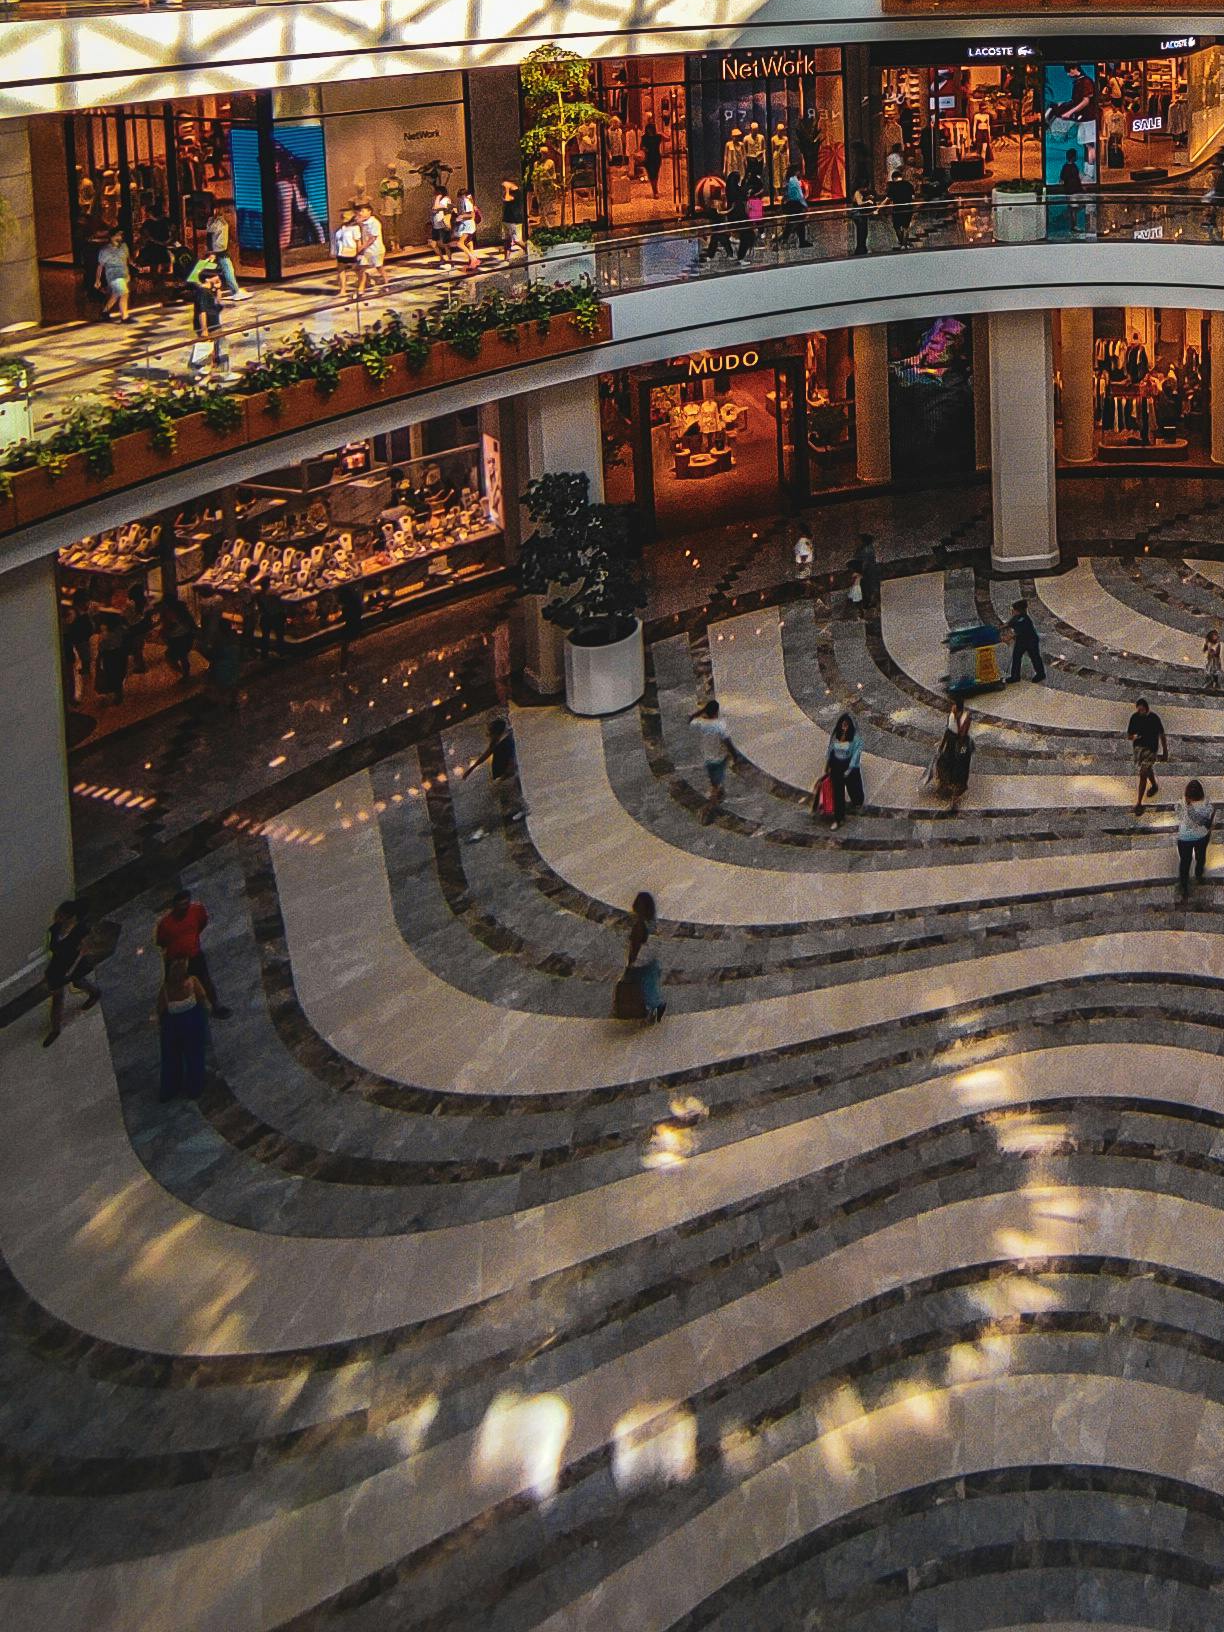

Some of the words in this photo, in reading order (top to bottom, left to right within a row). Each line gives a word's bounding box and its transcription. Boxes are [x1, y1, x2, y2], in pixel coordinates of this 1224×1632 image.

[968, 46, 1014, 57] LACOSTE
[1132, 117, 1162, 132] SALE
[688, 351, 759, 376] MUDO
